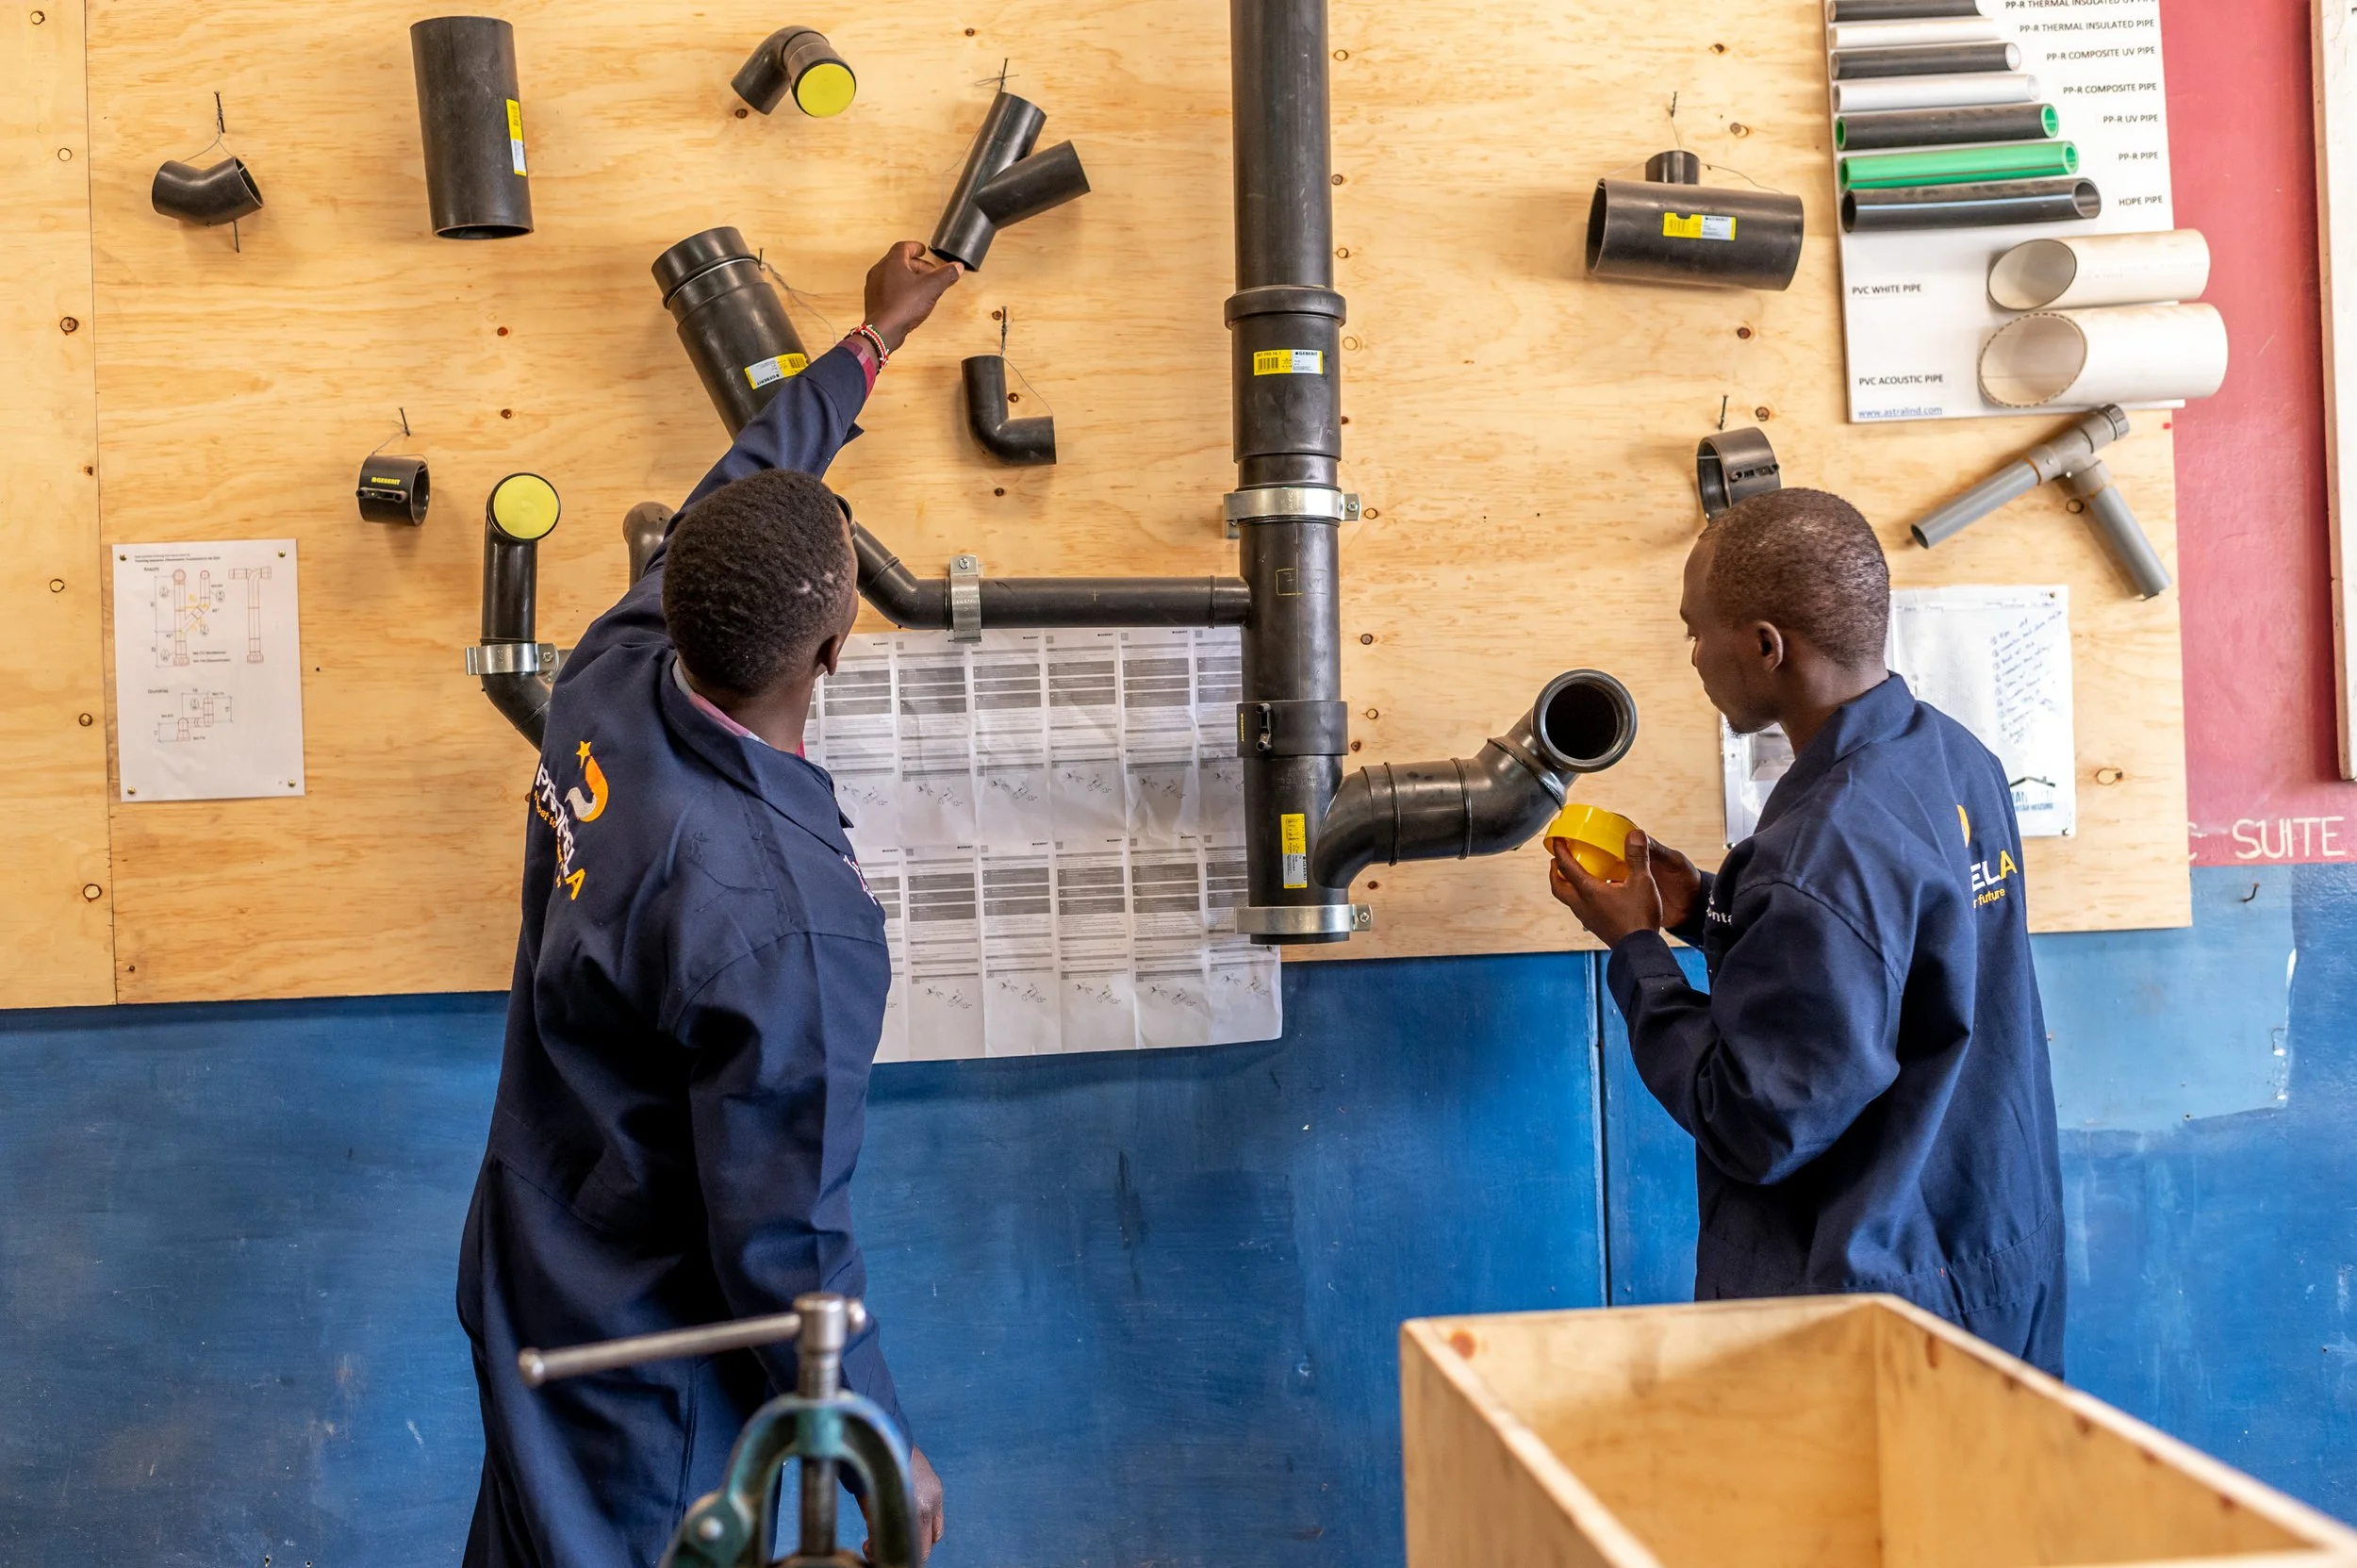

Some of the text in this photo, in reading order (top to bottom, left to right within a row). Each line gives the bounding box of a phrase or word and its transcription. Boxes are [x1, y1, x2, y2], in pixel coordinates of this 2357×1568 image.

[2005, 0, 2025, 9] PP-R
[2019, 19, 2154, 33] PP-R THERMAL INSULATED PIPE
[2069, 48, 2119, 59] COMPOSITE
[2137, 46, 2155, 55] PIPE
[2063, 82, 2157, 94] PP-R COMPOSITE PIPE
[2102, 115, 2122, 124] PP-R
[2140, 113, 2158, 122] PIPE
[2118, 151, 2158, 161] PP-R PIPE
[2118, 194, 2163, 206] HDPE PIPE
[1852, 283, 1921, 294] PVC WHITE PIPE
[1858, 373, 1943, 386] PVC ACOUSTIC PIPE
[2233, 816, 2346, 859] SUITE
[1970, 850, 2018, 893] ELA
[1978, 888, 2005, 906] future
